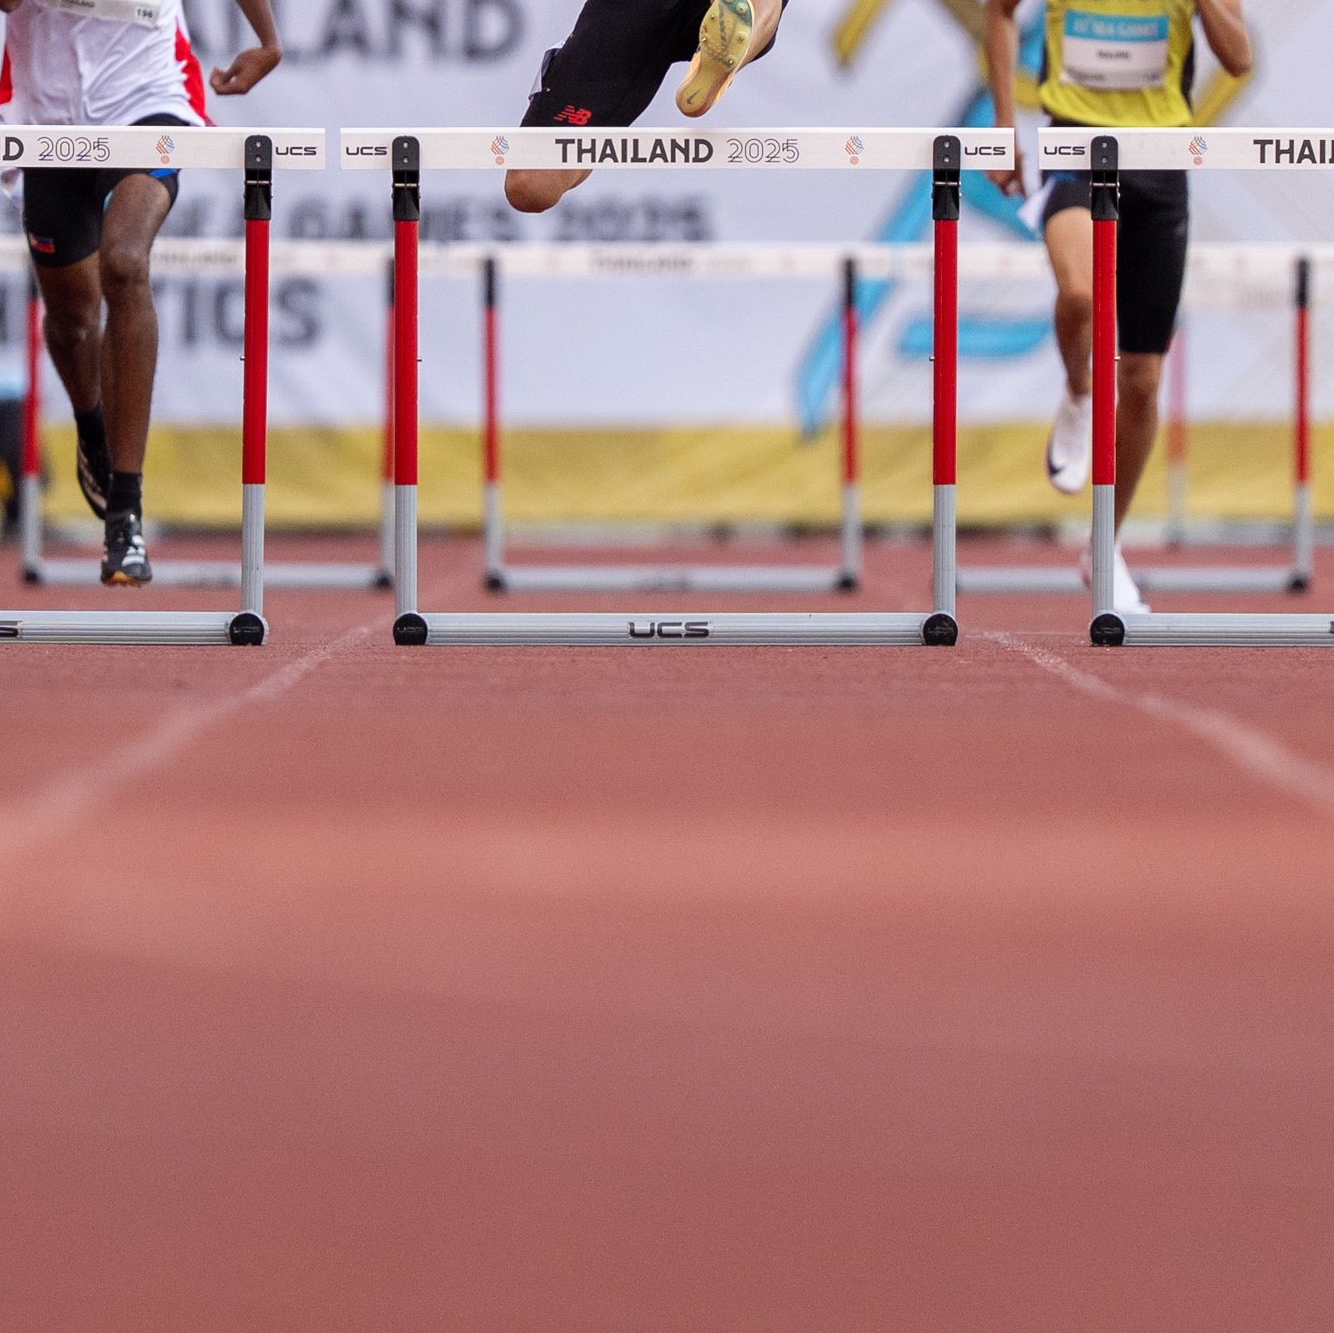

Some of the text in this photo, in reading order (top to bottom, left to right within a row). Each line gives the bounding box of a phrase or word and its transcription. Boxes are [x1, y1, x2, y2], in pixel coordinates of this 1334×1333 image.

[37, 136, 111, 162] 2025
[275, 146, 317, 156] UCS
[346, 146, 388, 156] UCS
[555, 138, 800, 164] THAILAND 2025
[964, 146, 1006, 156] UCS
[1044, 146, 1086, 156] UCS
[629, 621, 711, 638] UCS
